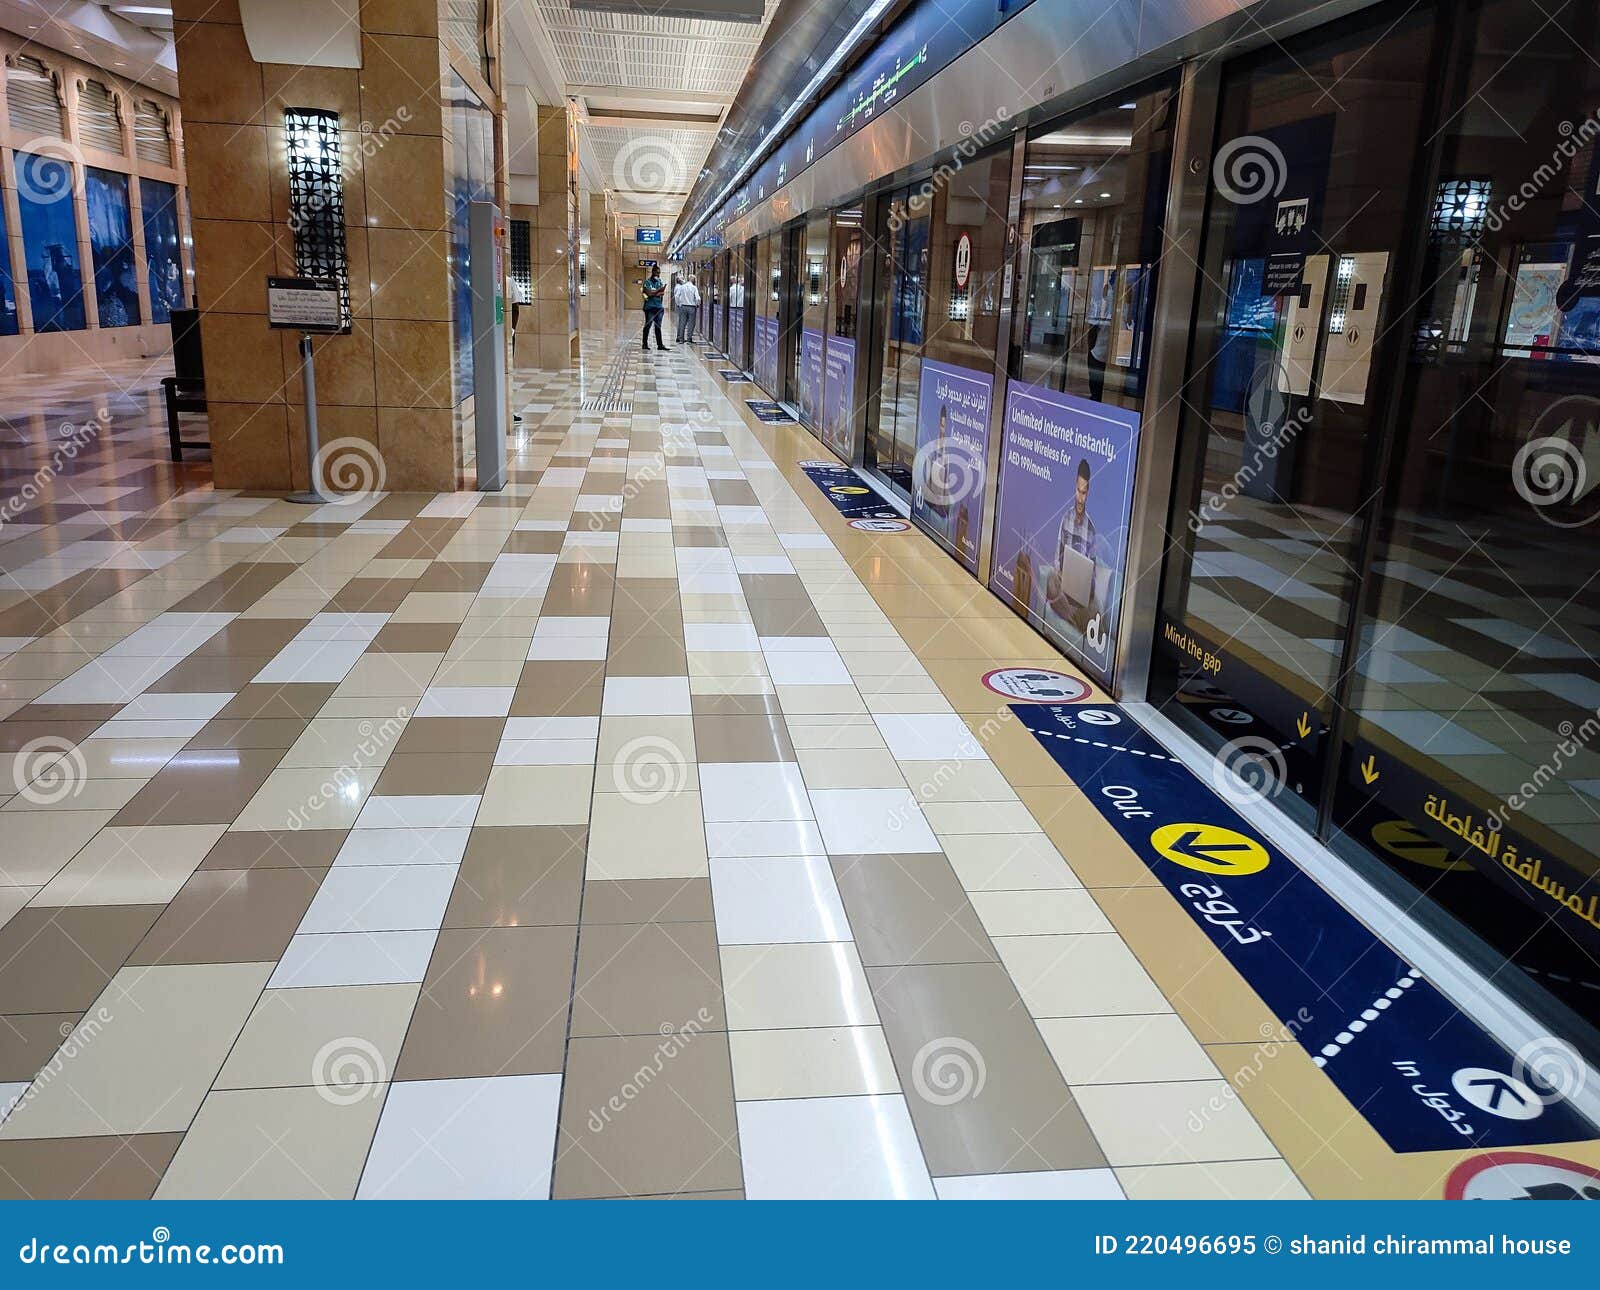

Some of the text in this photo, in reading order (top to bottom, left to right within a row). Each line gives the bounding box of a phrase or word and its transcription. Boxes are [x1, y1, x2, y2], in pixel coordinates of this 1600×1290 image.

[1008, 450, 1020, 466] AED
[1009, 429, 1071, 467] du Home Wireless for
[1011, 407, 1117, 462] Unlimited Internet instantly.
[1164, 623, 1222, 676] Mind the gap
[1101, 785, 1154, 819] Out
[1424, 794, 1501, 858] الفاصلة
[1180, 883, 1273, 945] خروج
[1391, 1060, 1421, 1077] In
[1411, 1084, 1475, 1136] دخول
